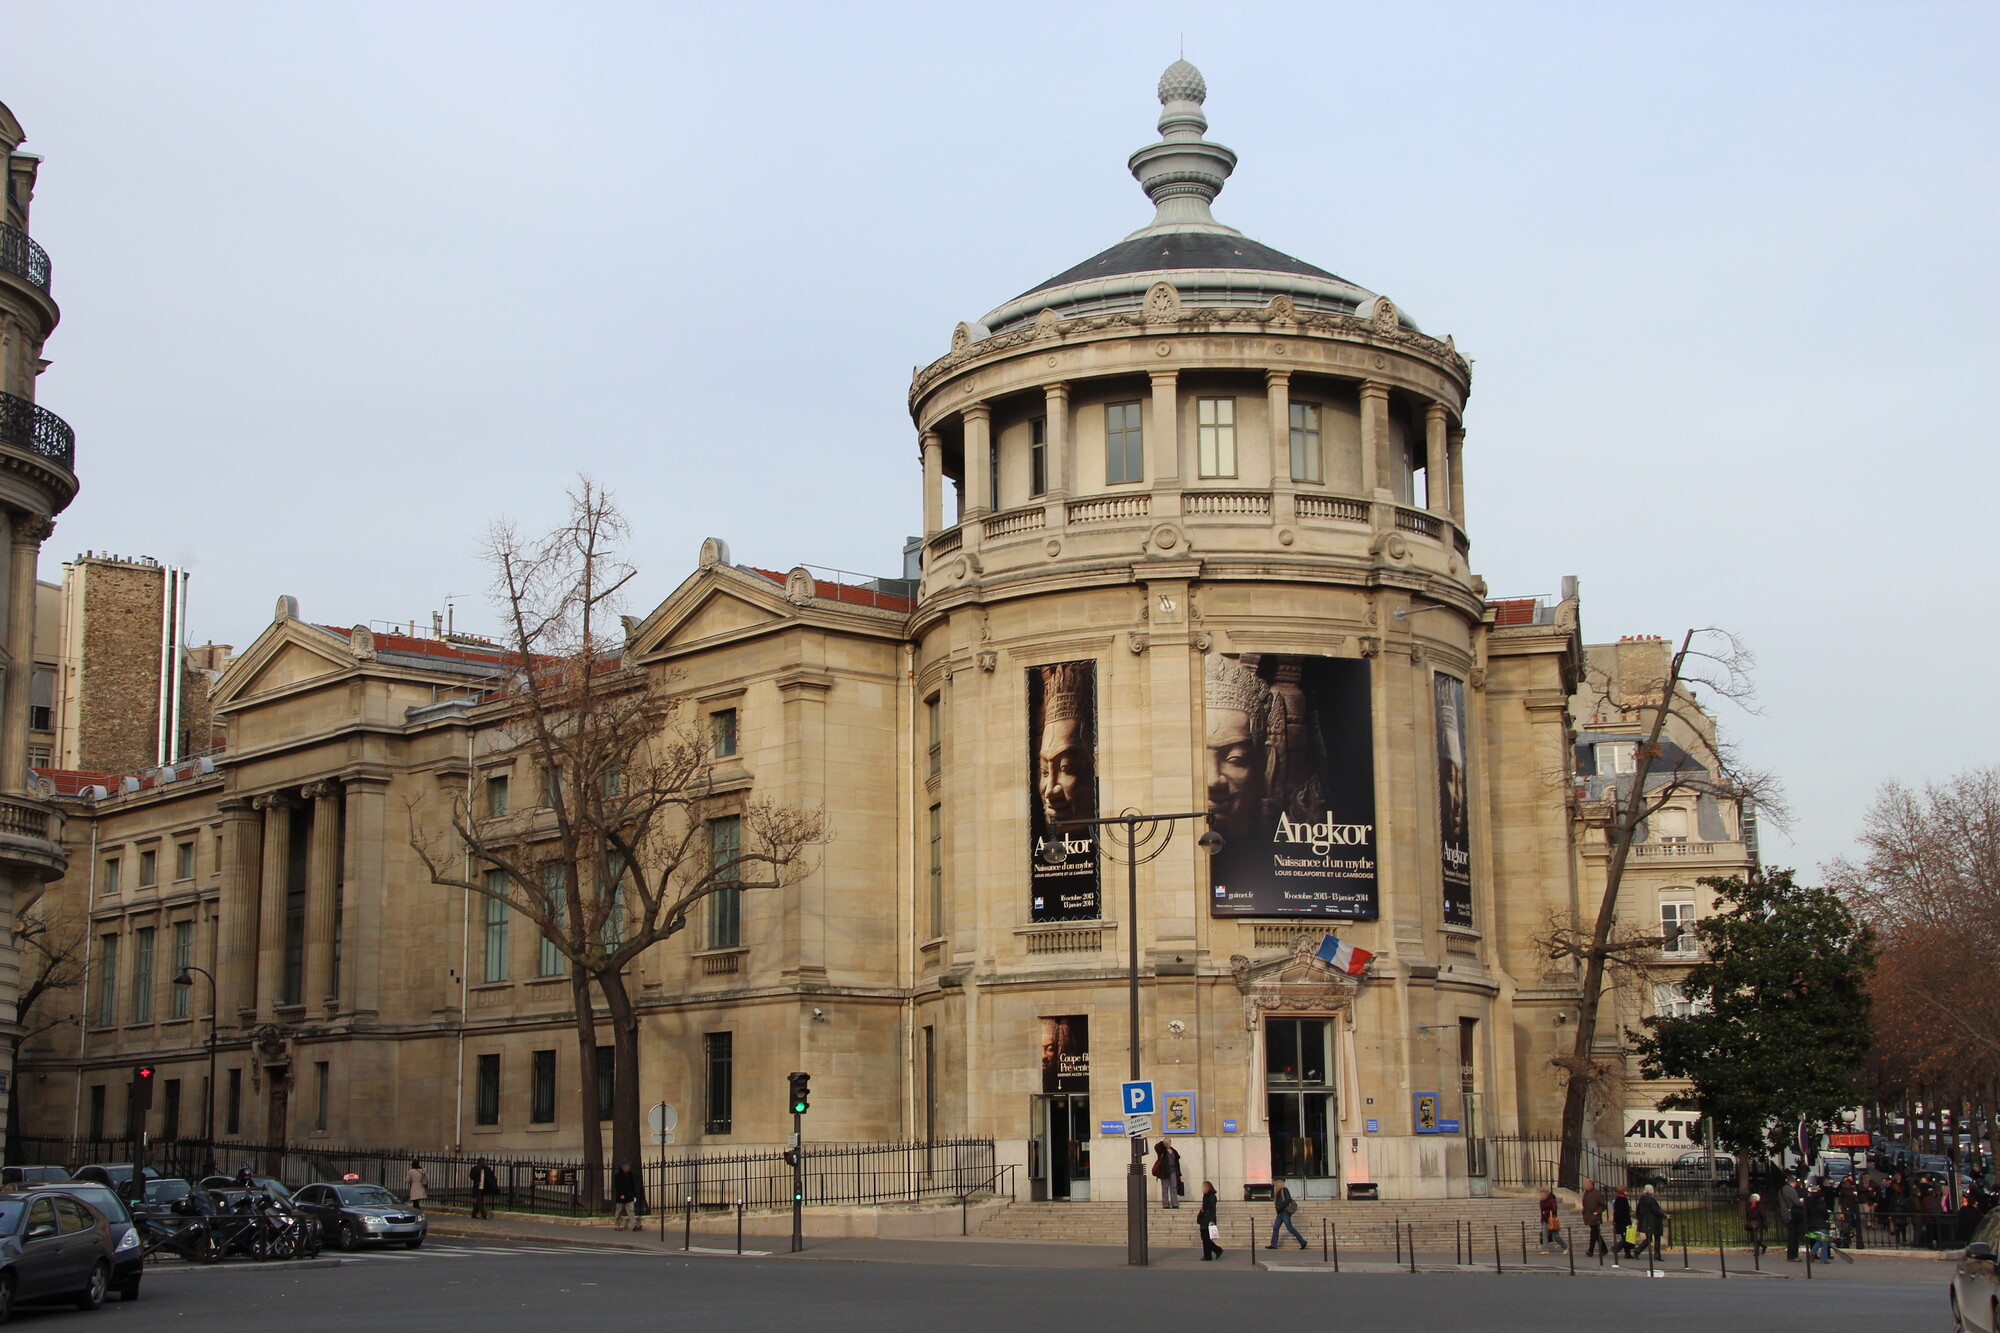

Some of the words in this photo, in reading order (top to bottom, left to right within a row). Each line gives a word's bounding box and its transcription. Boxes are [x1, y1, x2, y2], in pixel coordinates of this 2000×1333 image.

[1273, 811, 1373, 855] Angkor
[1034, 832, 1093, 862] Akor
[1443, 841, 1468, 869] Angkor
[1075, 860, 1094, 871] mythe
[1274, 854, 1320, 867] Naissance
[1322, 855, 1343, 868] d'un
[1345, 856, 1374, 872] mythe
[1292, 892, 1312, 900] octobre
[1060, 1053, 1081, 1064] Coupe
[1131, 1088, 1146, 1109] P
